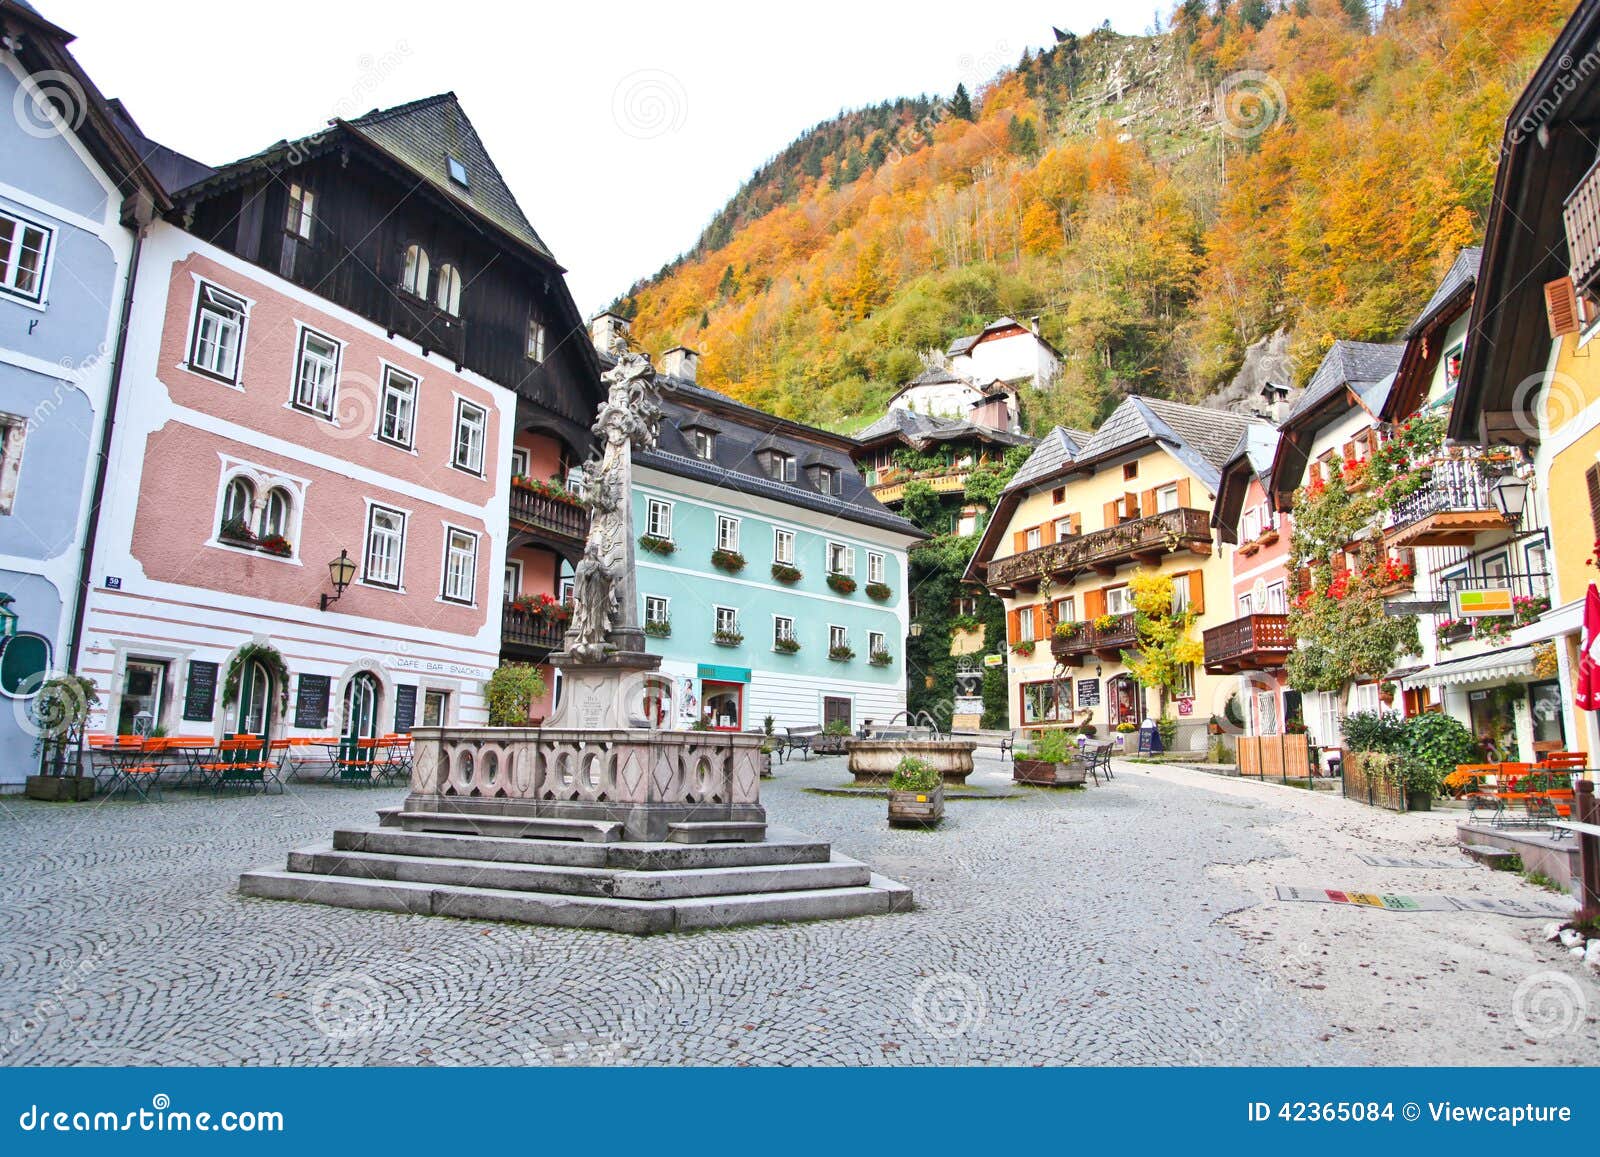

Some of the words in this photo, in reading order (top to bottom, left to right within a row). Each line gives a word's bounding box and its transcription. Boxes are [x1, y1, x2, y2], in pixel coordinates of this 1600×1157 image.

[109, 577, 119, 585] 59
[426, 662, 444, 671] BAR
[450, 665, 481, 677] SNACKS
